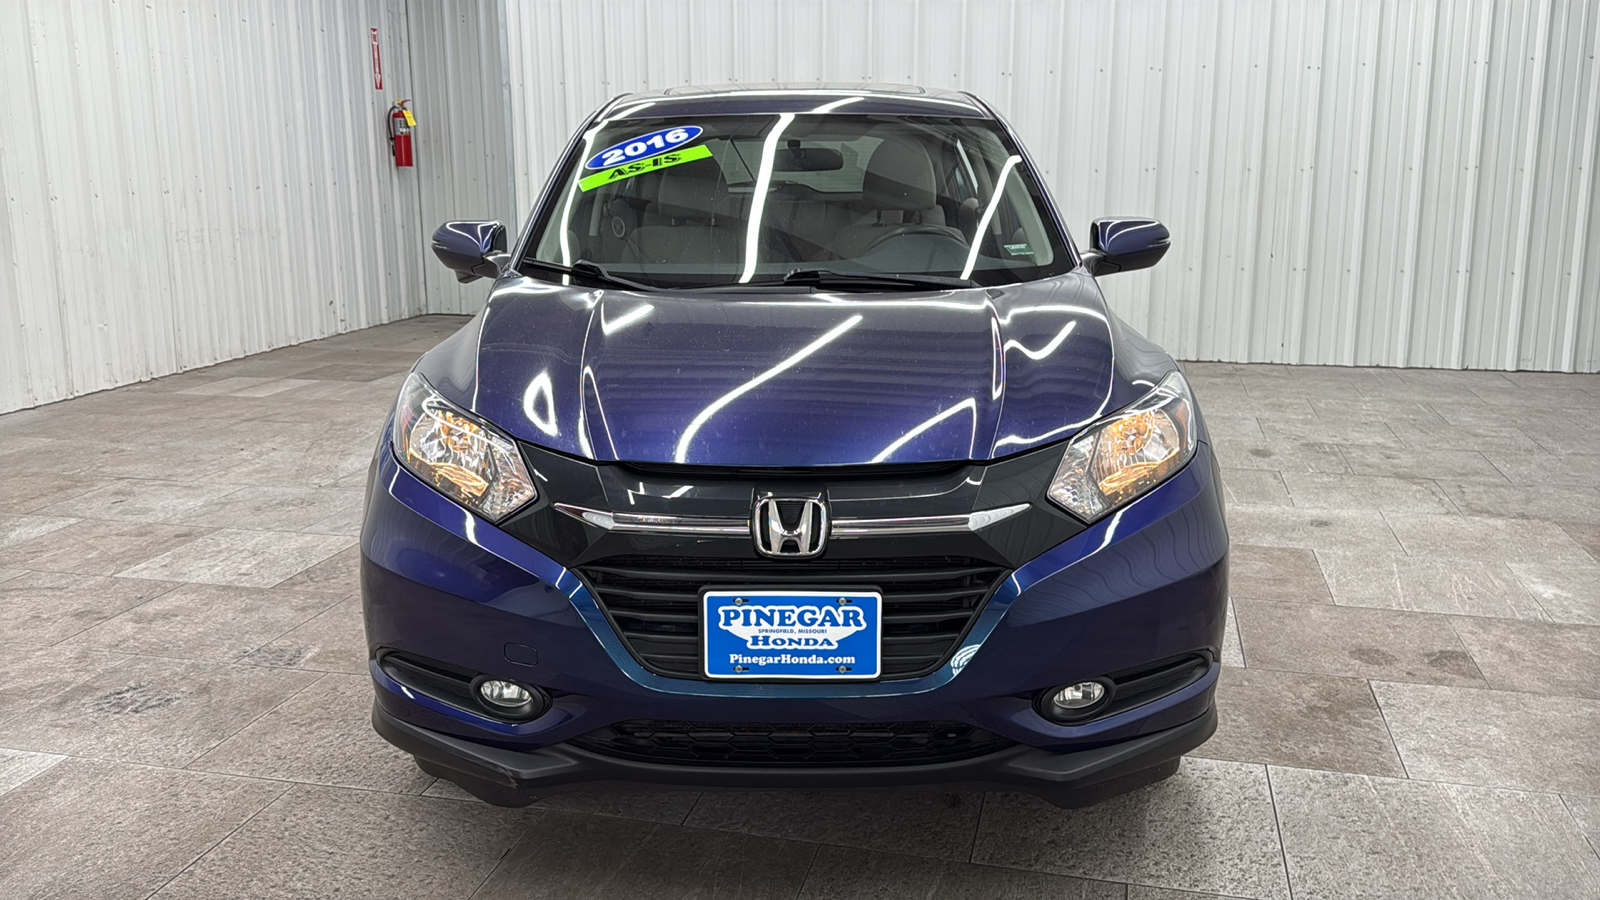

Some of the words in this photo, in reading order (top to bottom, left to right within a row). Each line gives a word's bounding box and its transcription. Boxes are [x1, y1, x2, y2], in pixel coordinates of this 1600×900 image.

[601, 128, 689, 166] 2016
[608, 154, 682, 179] AS-IS
[722, 609, 864, 627] PINEGAR
[729, 654, 856, 665] PinegarHonda.com
